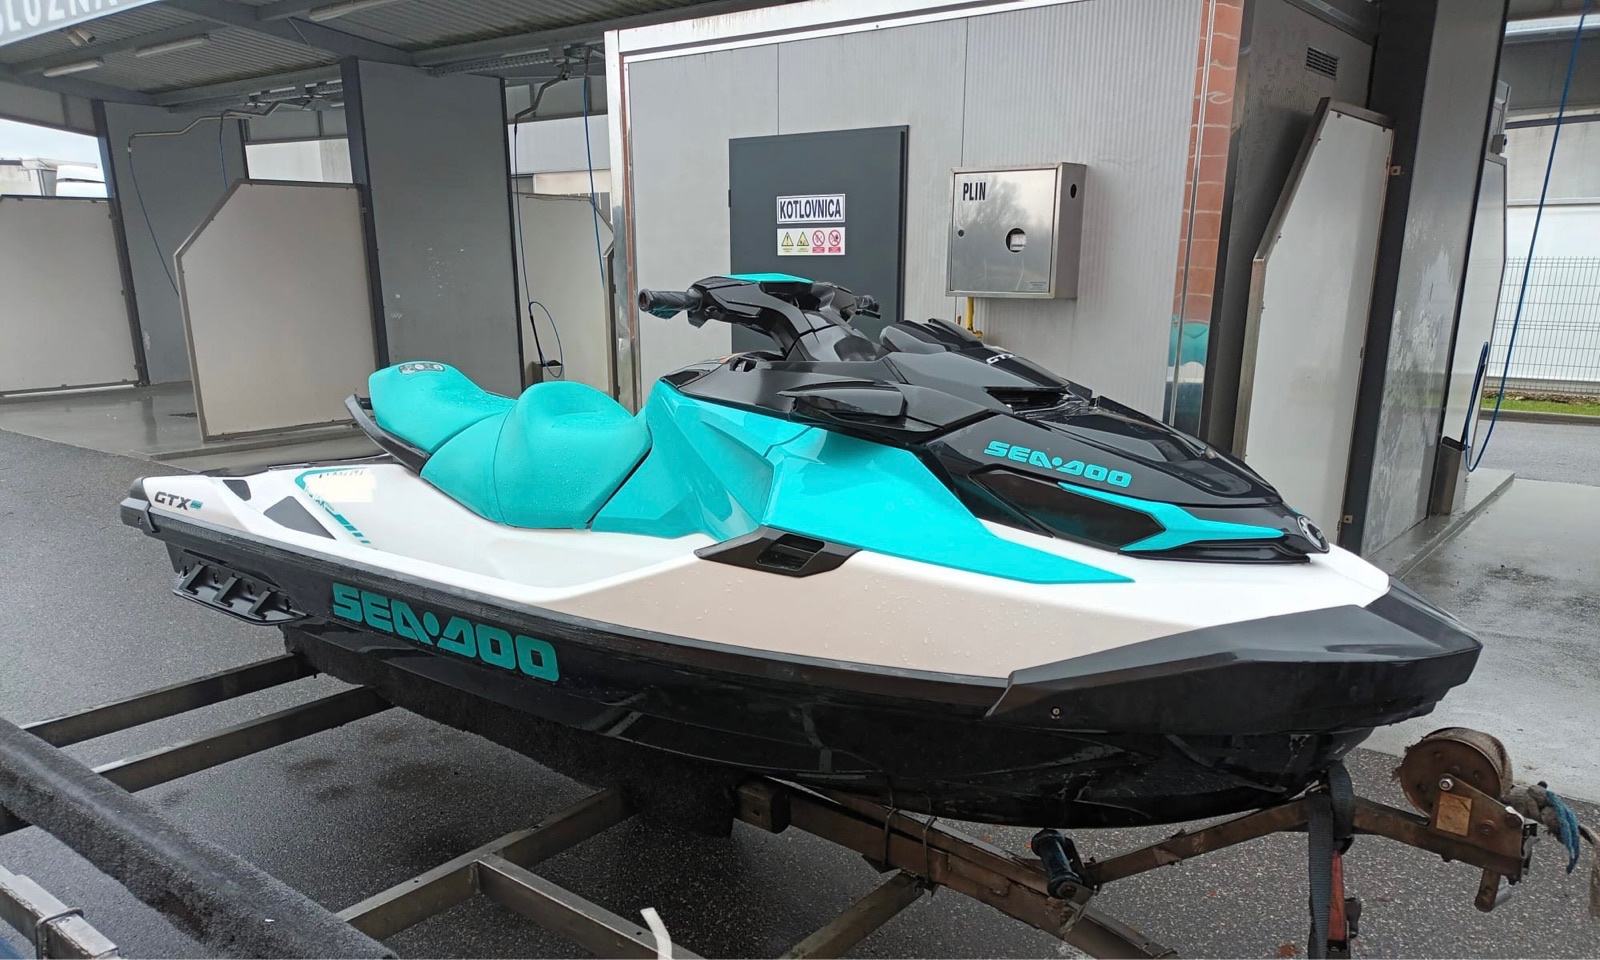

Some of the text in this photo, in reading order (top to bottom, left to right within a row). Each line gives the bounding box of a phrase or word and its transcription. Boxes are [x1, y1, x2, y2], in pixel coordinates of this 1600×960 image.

[962, 182, 986, 201] PLIN
[780, 198, 842, 219] KOTLOVNICA
[154, 491, 191, 510] GTX
